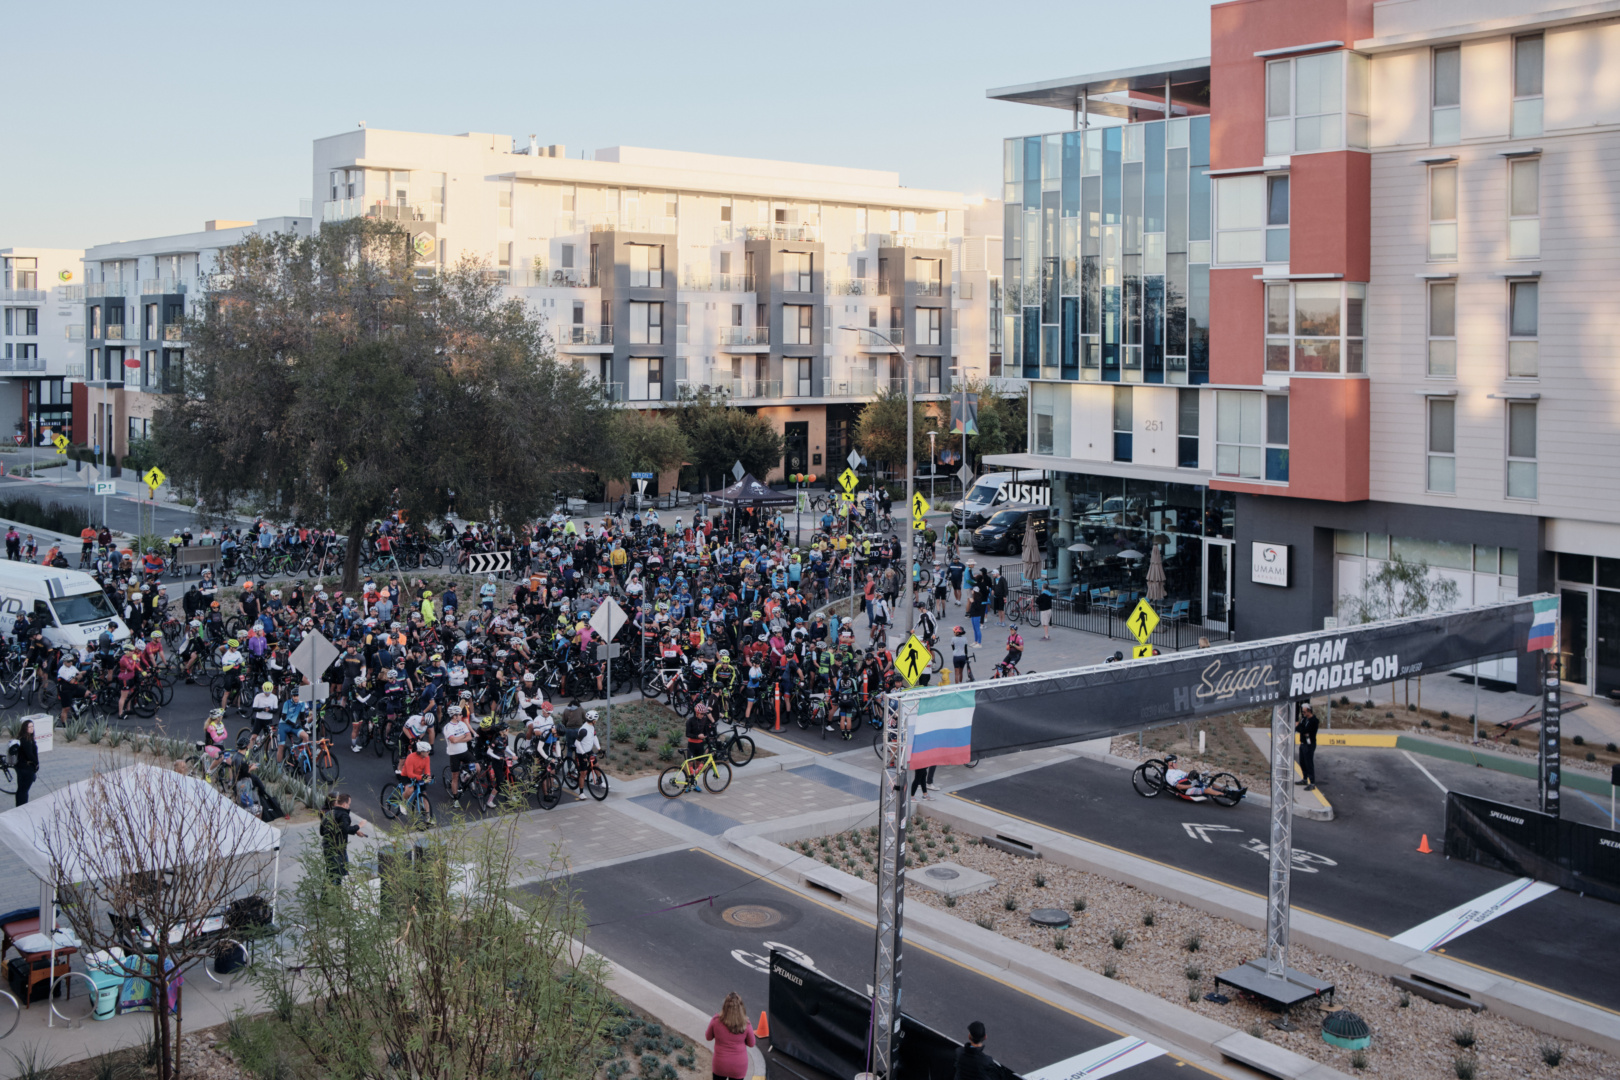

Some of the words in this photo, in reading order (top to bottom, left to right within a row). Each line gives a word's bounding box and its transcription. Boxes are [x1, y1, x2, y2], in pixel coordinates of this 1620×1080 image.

[1145, 420, 1163, 431] 251
[98, 484, 106, 492] P
[998, 482, 1050, 506] SUSHI
[1254, 564, 1286, 576] UMAMI
[82, 624, 108, 634] BOY
[1293, 638, 1348, 668] GRAN
[1196, 660, 1280, 700] Sagan
[1290, 654, 1398, 697] ROADIE-OH
[1250, 692, 1279, 703] FONDO
[1490, 810, 1524, 826] SPECIALIZED
[772, 964, 803, 986] SPECIALIZED
